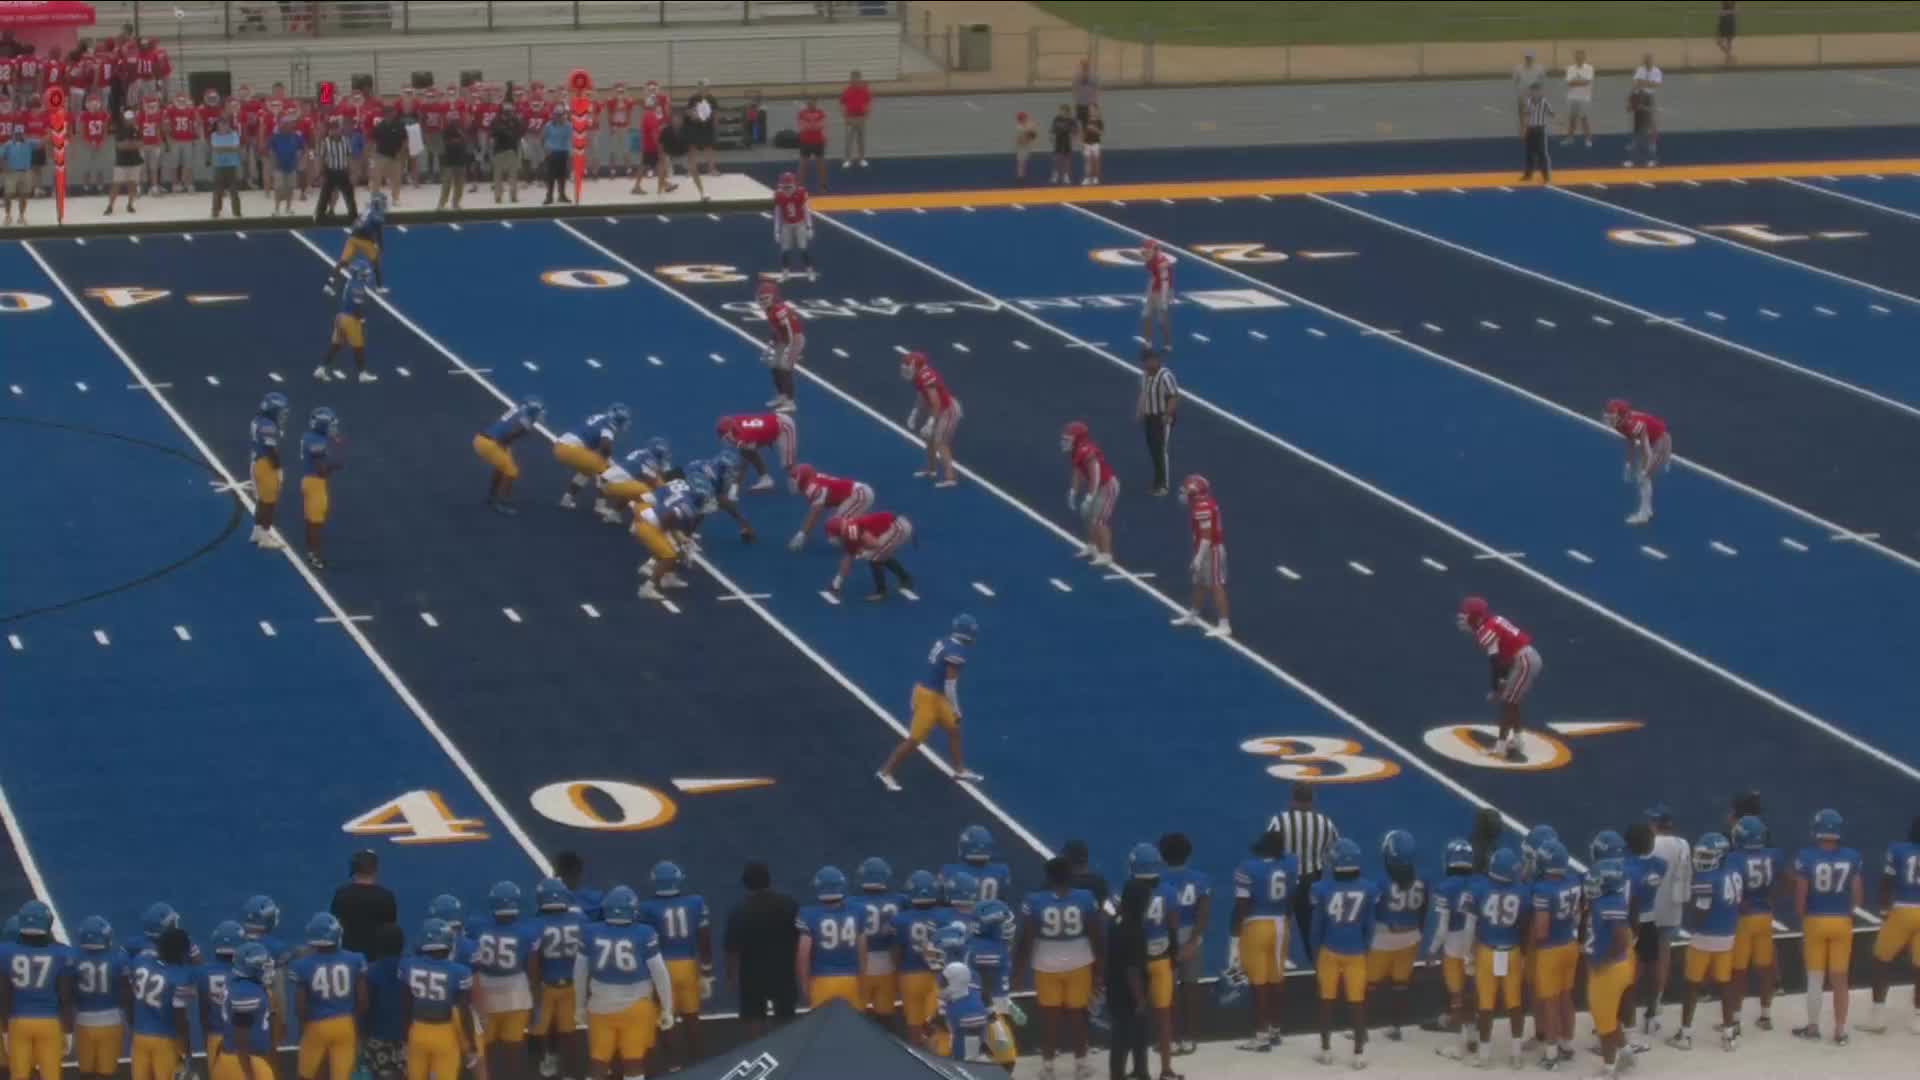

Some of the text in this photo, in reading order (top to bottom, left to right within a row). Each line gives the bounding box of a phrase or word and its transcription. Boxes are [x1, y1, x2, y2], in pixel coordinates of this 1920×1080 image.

[1269, 871, 1287, 900] 6
[1815, 862, 1850, 894] 87
[1041, 905, 1083, 936] 99
[1327, 891, 1365, 922] 47
[1482, 894, 1520, 925] 49
[663, 908, 689, 938] 11
[820, 917, 857, 950] 94
[479, 935, 518, 969] 65
[543, 925, 581, 958] 25
[595, 938, 637, 972] 76
[11, 955, 52, 988] 97
[78, 962, 108, 993] 31
[311, 964, 350, 998] 40
[409, 969, 447, 1001] 55
[134, 967, 165, 1009] 32
